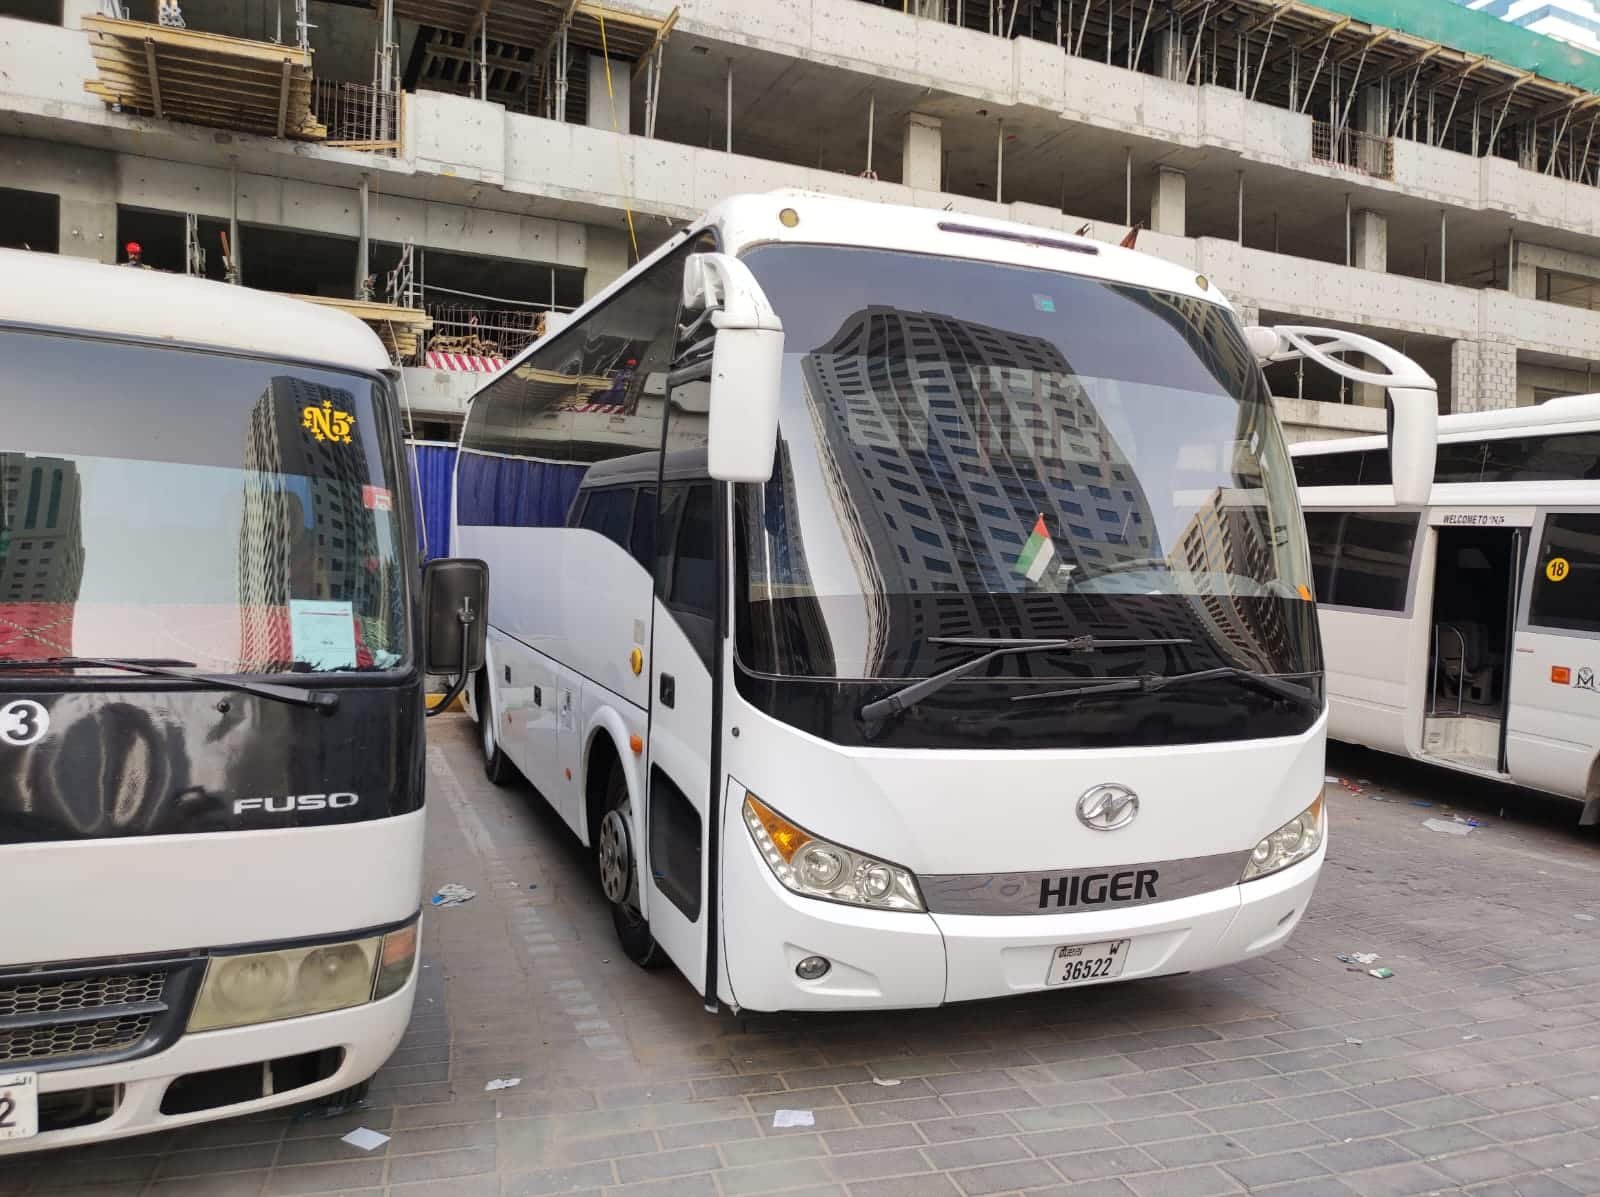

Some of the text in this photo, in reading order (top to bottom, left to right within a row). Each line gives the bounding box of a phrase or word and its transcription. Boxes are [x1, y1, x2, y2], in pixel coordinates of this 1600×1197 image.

[303, 406, 350, 442] N5
[1443, 514, 1477, 525] WELCOME
[1478, 514, 1488, 525] TO
[1551, 561, 1565, 577] 18
[6, 704, 39, 741] 3
[233, 792, 359, 815] FUSO
[1039, 869, 1159, 909] HIGER
[1109, 943, 1121, 955] W
[1062, 957, 1113, 981] 36522
